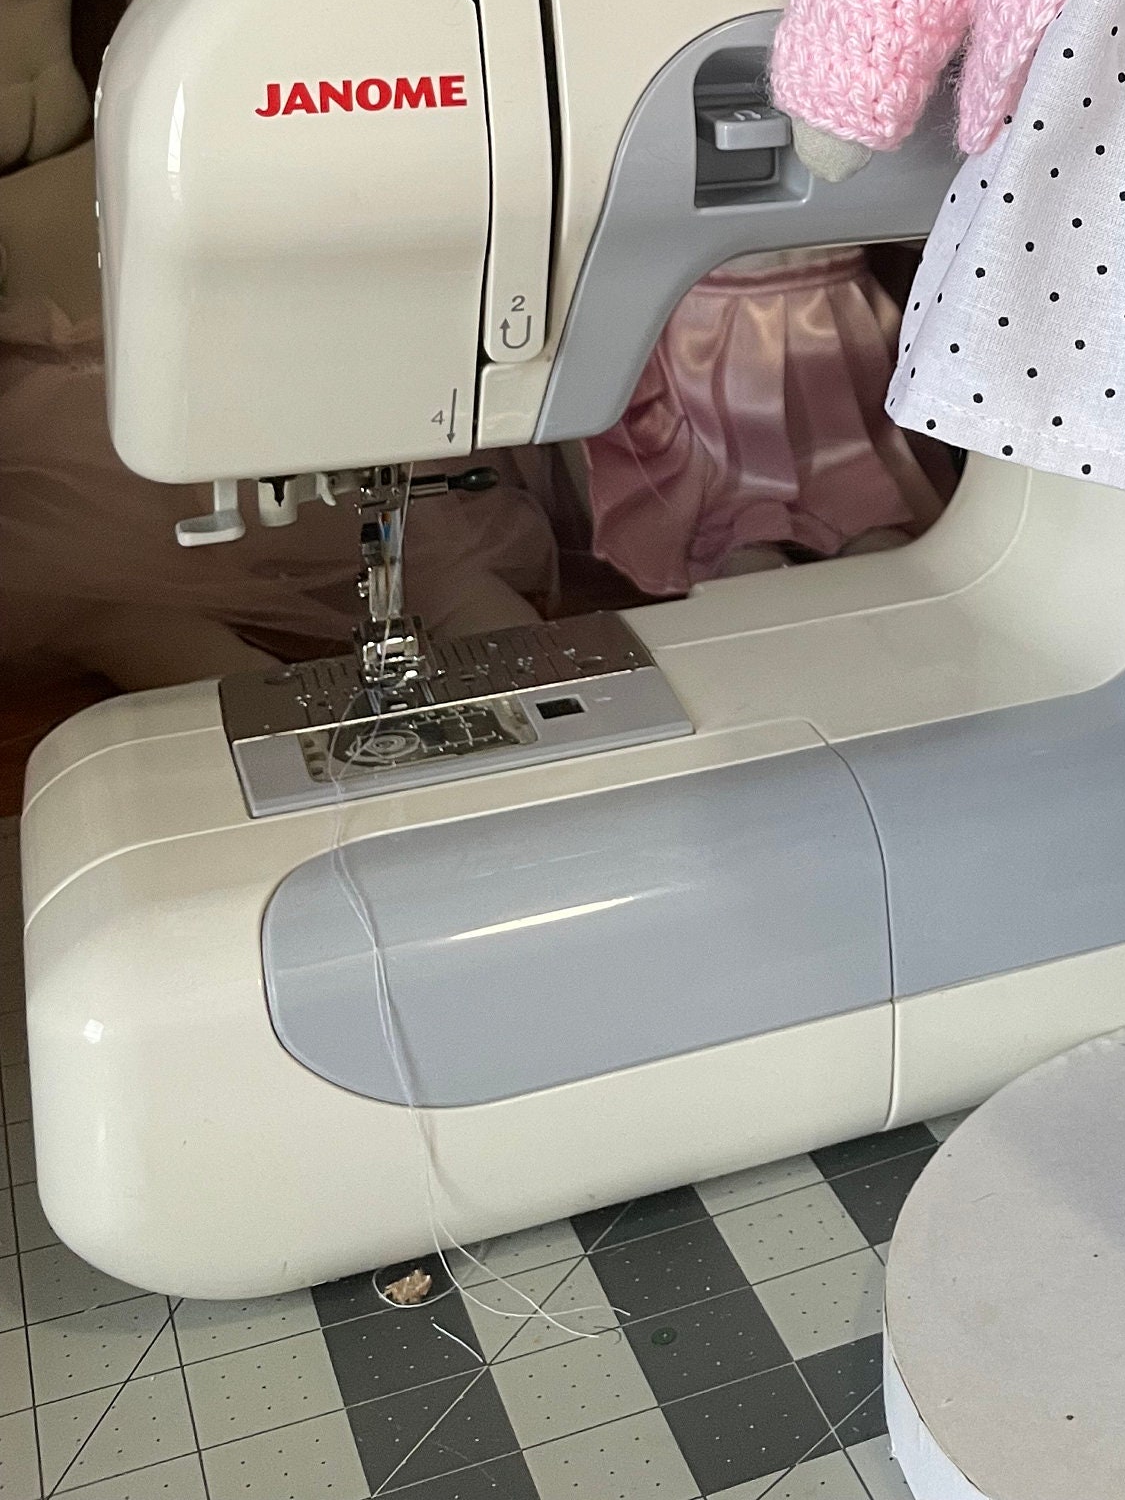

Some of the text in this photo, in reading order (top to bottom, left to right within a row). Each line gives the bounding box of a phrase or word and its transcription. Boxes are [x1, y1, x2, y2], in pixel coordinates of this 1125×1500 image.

[254, 75, 468, 118] JANOME
[511, 295, 526, 312] 2
[430, 409, 445, 426] 4
